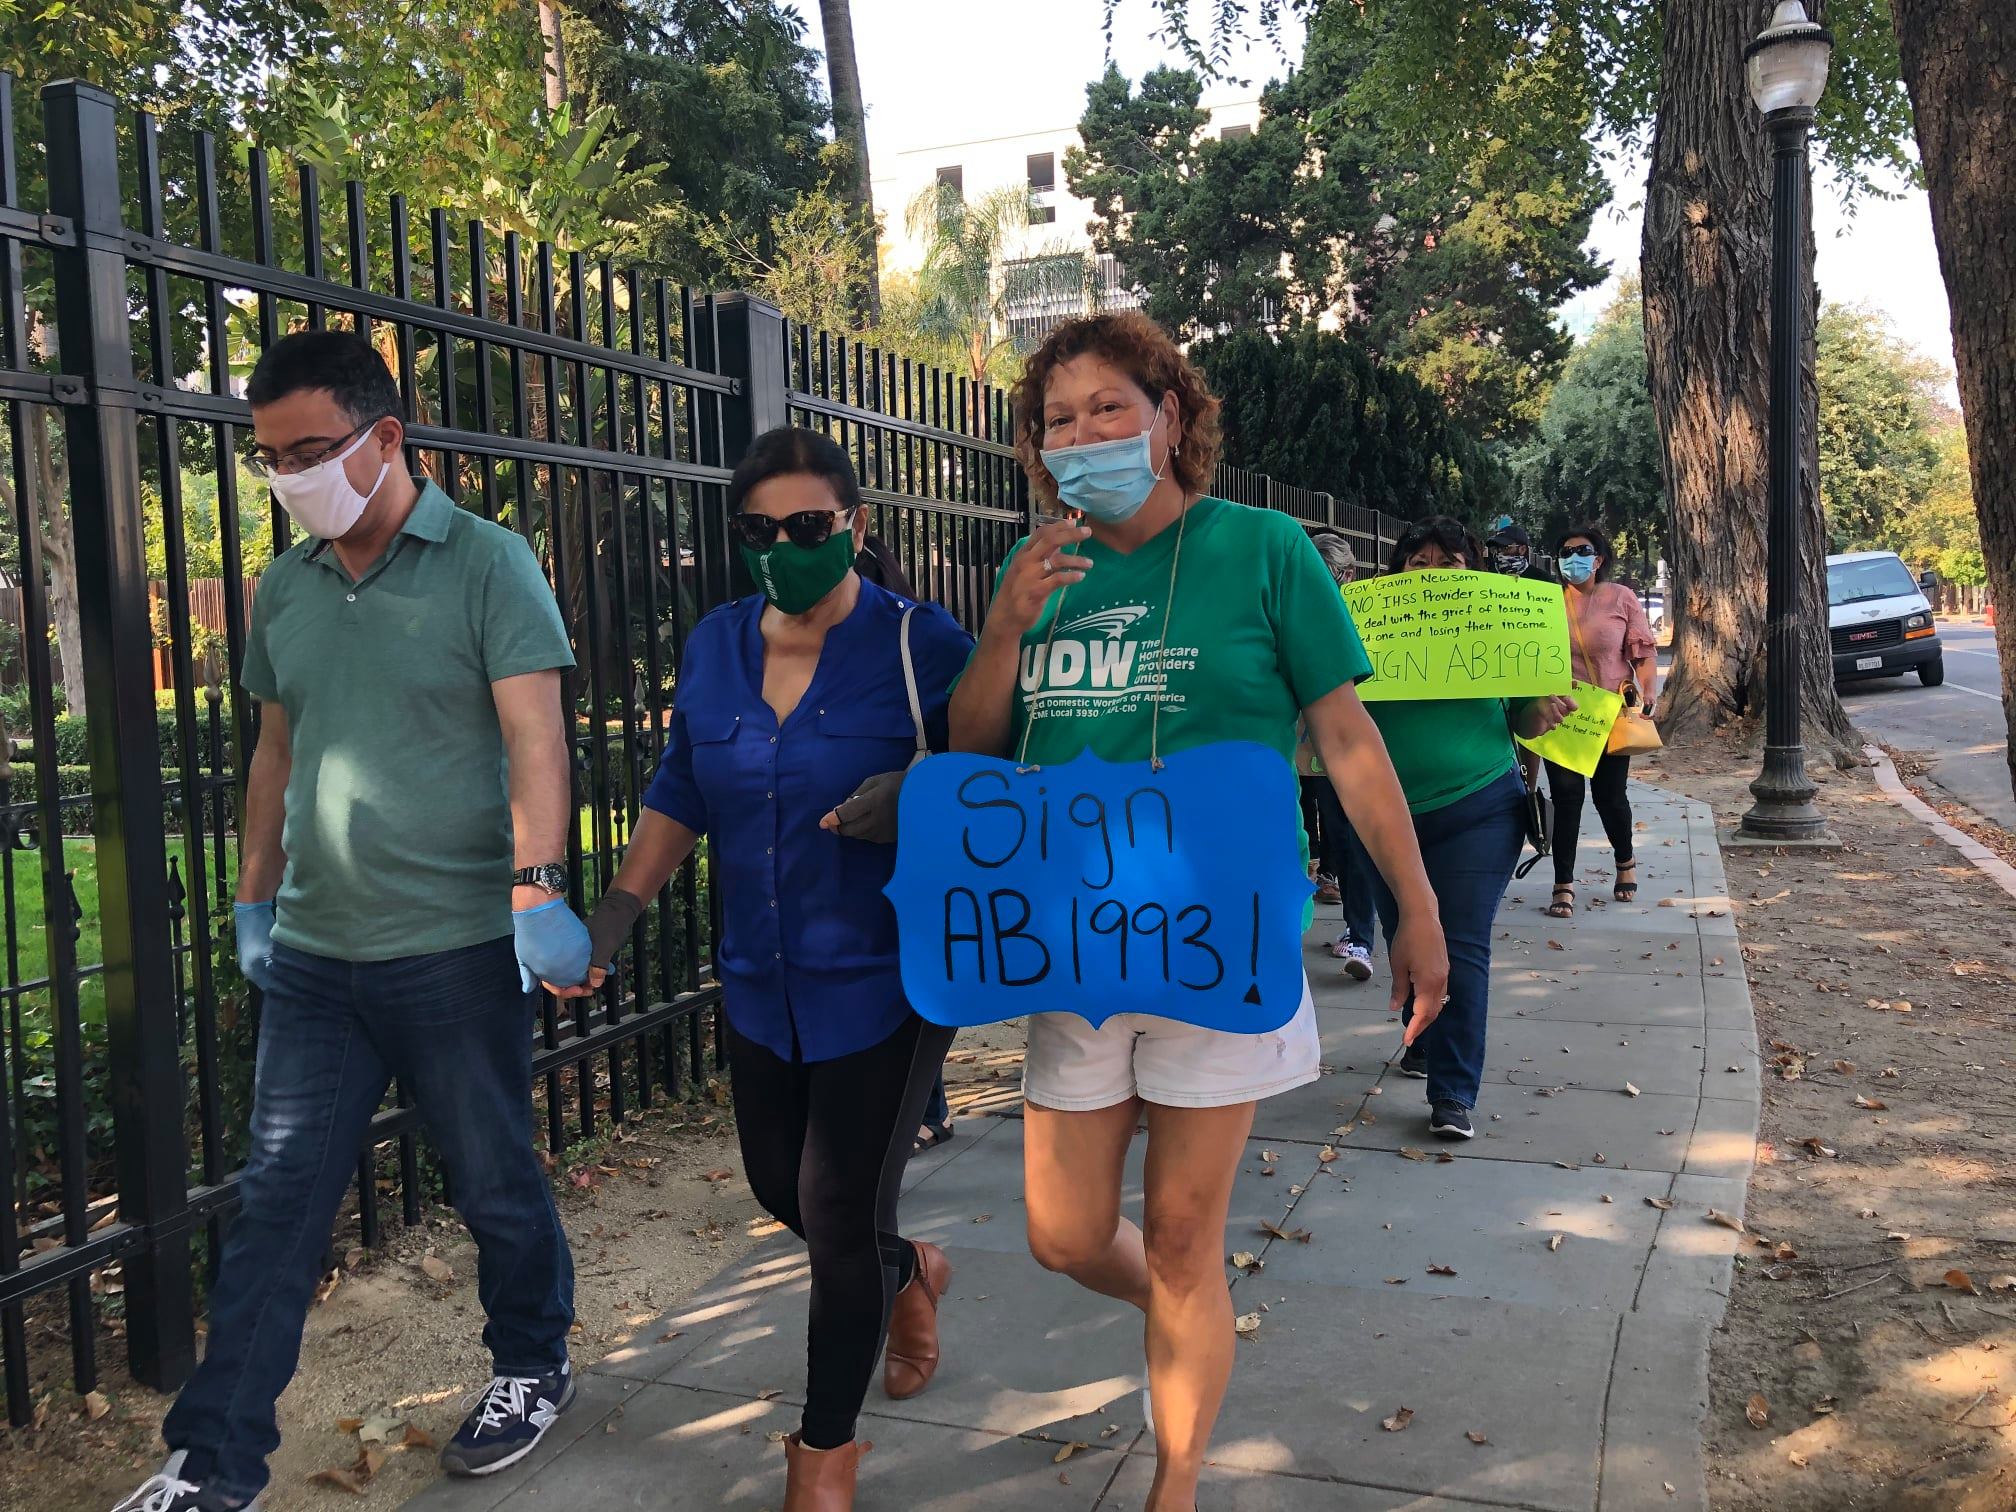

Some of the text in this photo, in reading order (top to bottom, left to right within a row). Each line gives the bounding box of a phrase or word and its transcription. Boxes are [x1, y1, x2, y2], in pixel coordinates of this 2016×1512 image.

[1375, 578, 1412, 591] Gavin
[1421, 574, 1479, 583] Newsom
[1350, 596, 1374, 615] NO
[1382, 593, 1417, 609] IHSS
[1423, 588, 1474, 602] Provider
[1527, 591, 1553, 604] have
[1364, 614, 1386, 628] deal
[1391, 613, 1415, 625] with
[1418, 609, 1437, 621] the
[1442, 605, 1472, 621] grief
[1479, 605, 1492, 613] of
[1498, 604, 1531, 616] losing
[1376, 632, 1395, 642] one
[1401, 627, 1422, 638] and
[1430, 626, 1460, 638] losing
[1465, 620, 1494, 632] their
[1141, 639, 1160, 650] The
[1139, 647, 1199, 662] Homecare
[1020, 639, 1138, 692] UDW
[1047, 698, 1090, 707] Domestic
[1130, 694, 1141, 702] of
[1144, 693, 1185, 702] America
[1051, 708, 1072, 717] Local
[1076, 709, 1099, 718] 3930
[957, 770, 1174, 890] Sign
